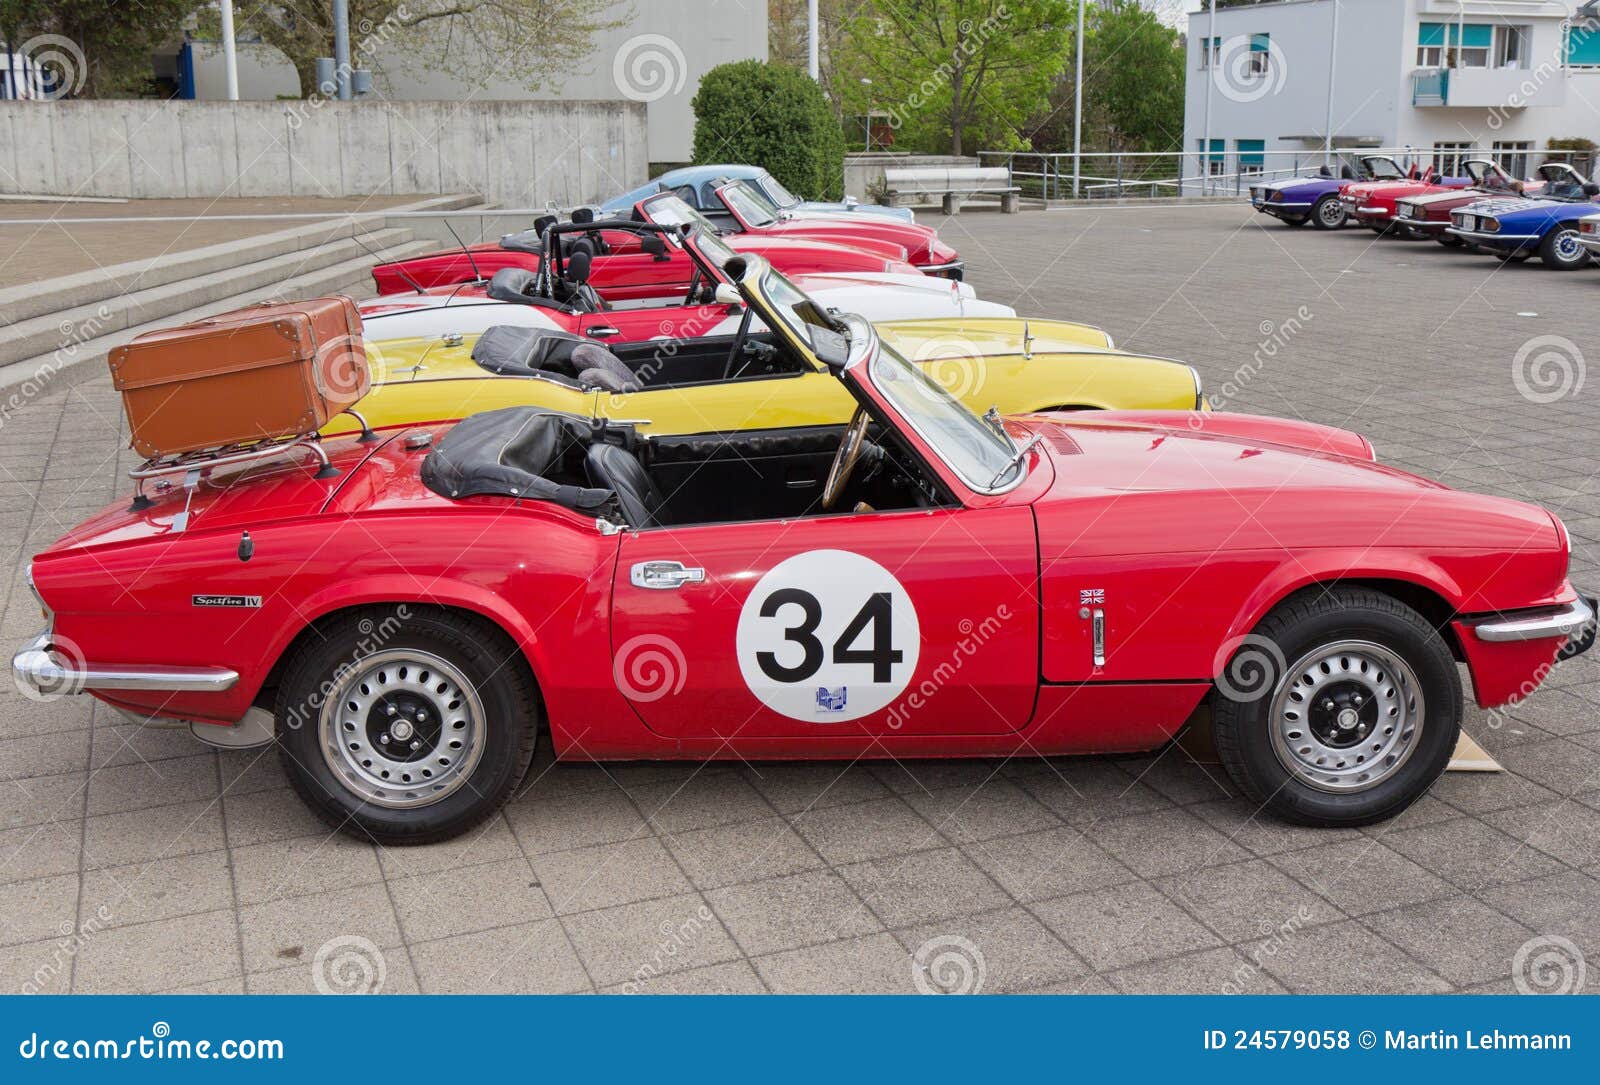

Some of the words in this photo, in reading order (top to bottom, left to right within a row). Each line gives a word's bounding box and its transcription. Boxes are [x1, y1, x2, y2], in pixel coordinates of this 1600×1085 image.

[195, 596, 242, 605] Spitfire
[247, 597, 260, 605] IV
[756, 588, 903, 683] 34
